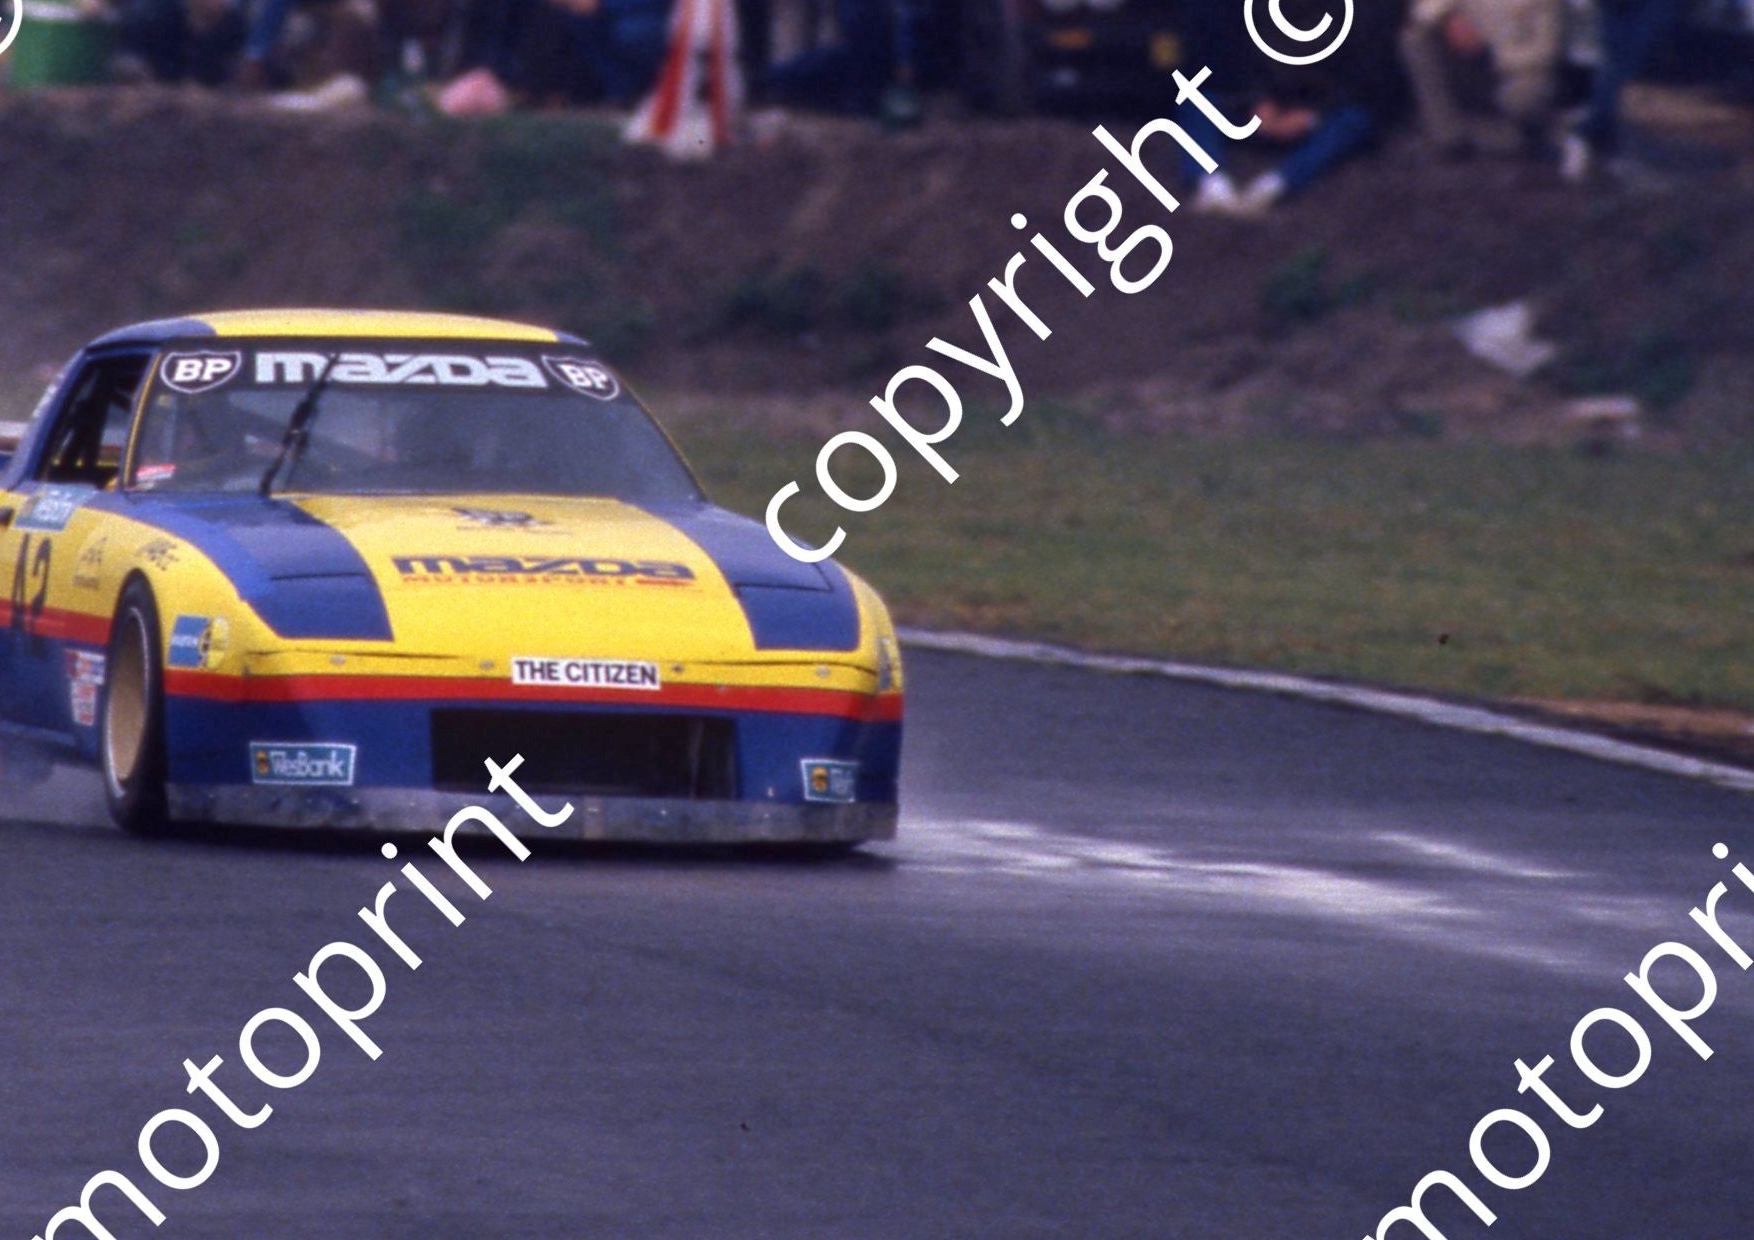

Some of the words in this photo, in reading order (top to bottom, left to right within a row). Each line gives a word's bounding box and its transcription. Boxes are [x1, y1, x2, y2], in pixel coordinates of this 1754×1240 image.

[172, 358, 232, 382] BP
[558, 363, 608, 390] BP
[515, 660, 560, 682] THE
[564, 662, 658, 685] CITIZEN
